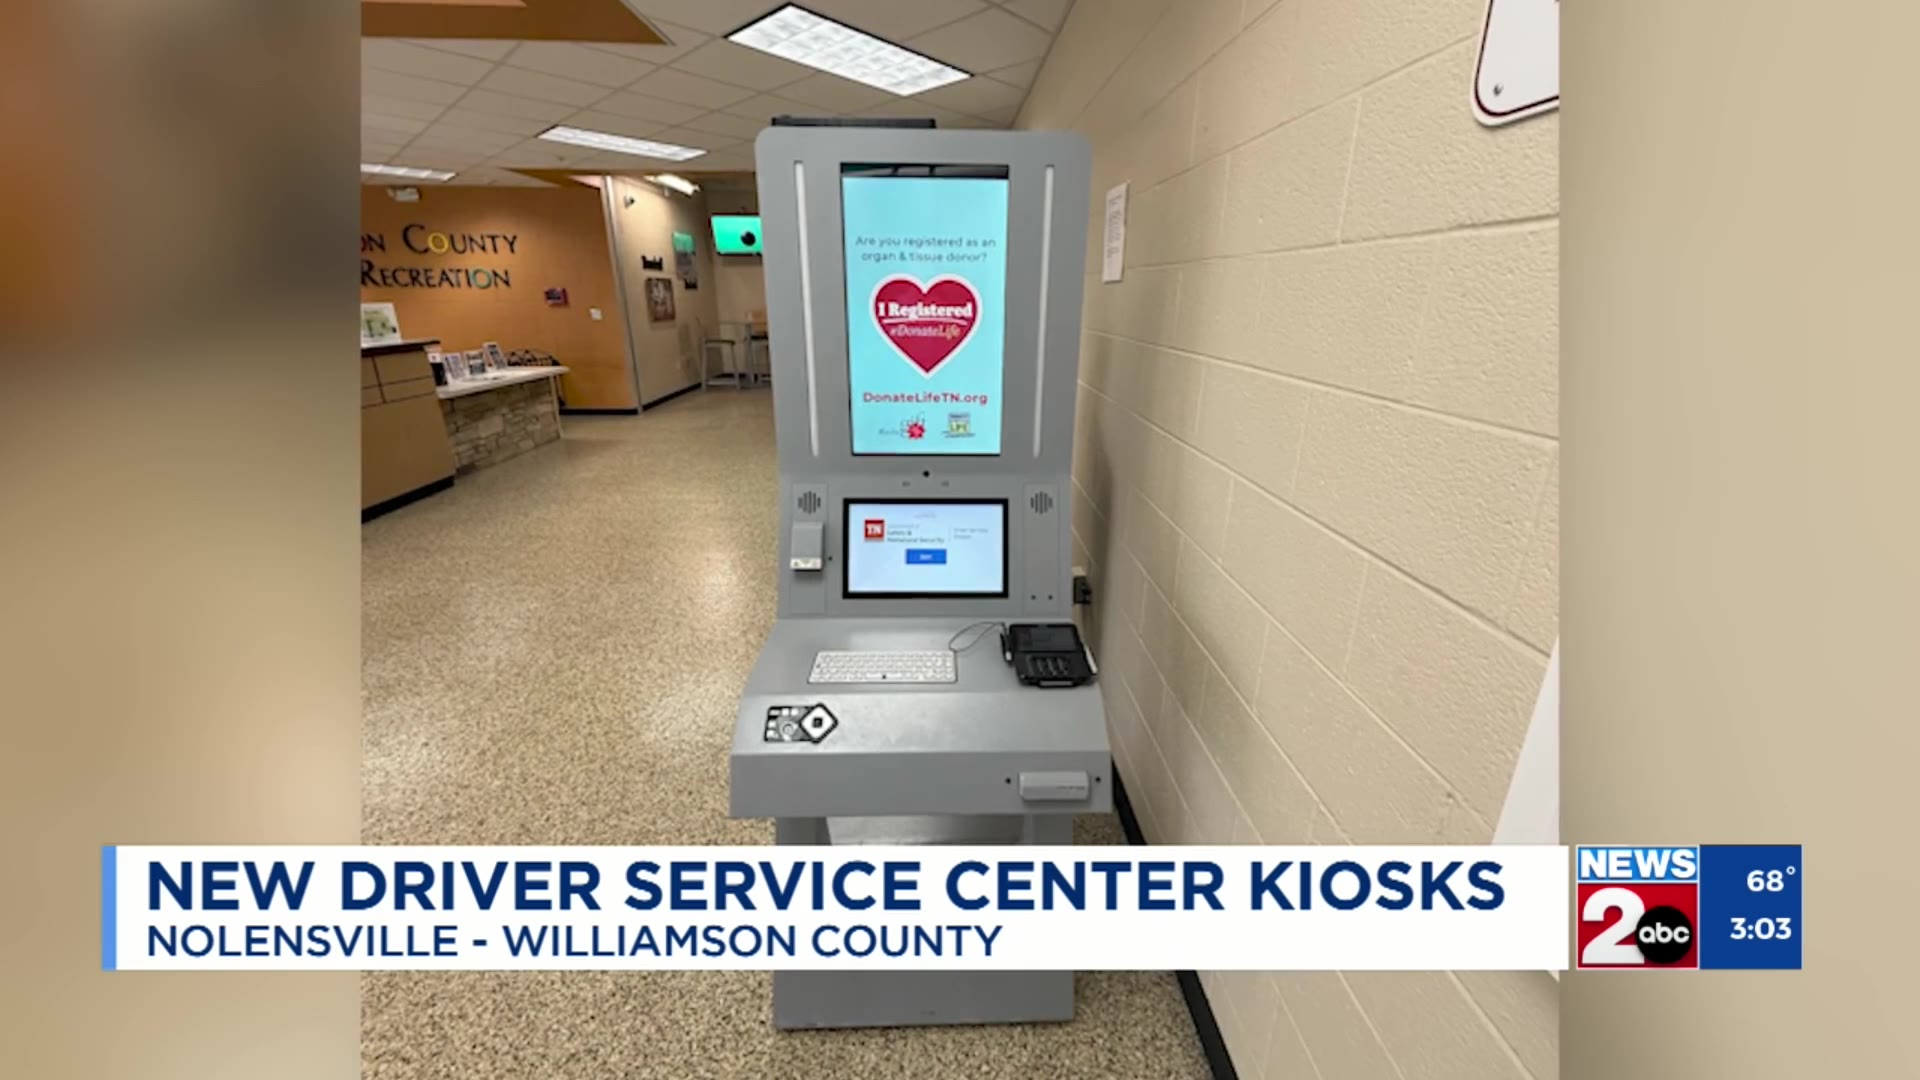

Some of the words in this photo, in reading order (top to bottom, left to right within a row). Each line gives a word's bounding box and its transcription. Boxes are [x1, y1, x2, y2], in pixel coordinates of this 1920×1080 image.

[402, 223, 518, 254] COUNTY
[855, 236, 877, 246] Are
[878, 238, 901, 248] you
[903, 236, 962, 248] registered
[965, 239, 979, 247] as
[981, 239, 997, 247] an
[861, 253, 896, 263] organ
[899, 252, 907, 261] &
[909, 252, 944, 262] tissue
[946, 252, 988, 262] donor?
[361, 259, 511, 290] RECREATION
[878, 303, 885, 317] I
[888, 302, 973, 320] Registered
[890, 324, 961, 340] #DonateLife
[863, 391, 988, 406] DonateLifeTN.org
[866, 524, 882, 535] TN
